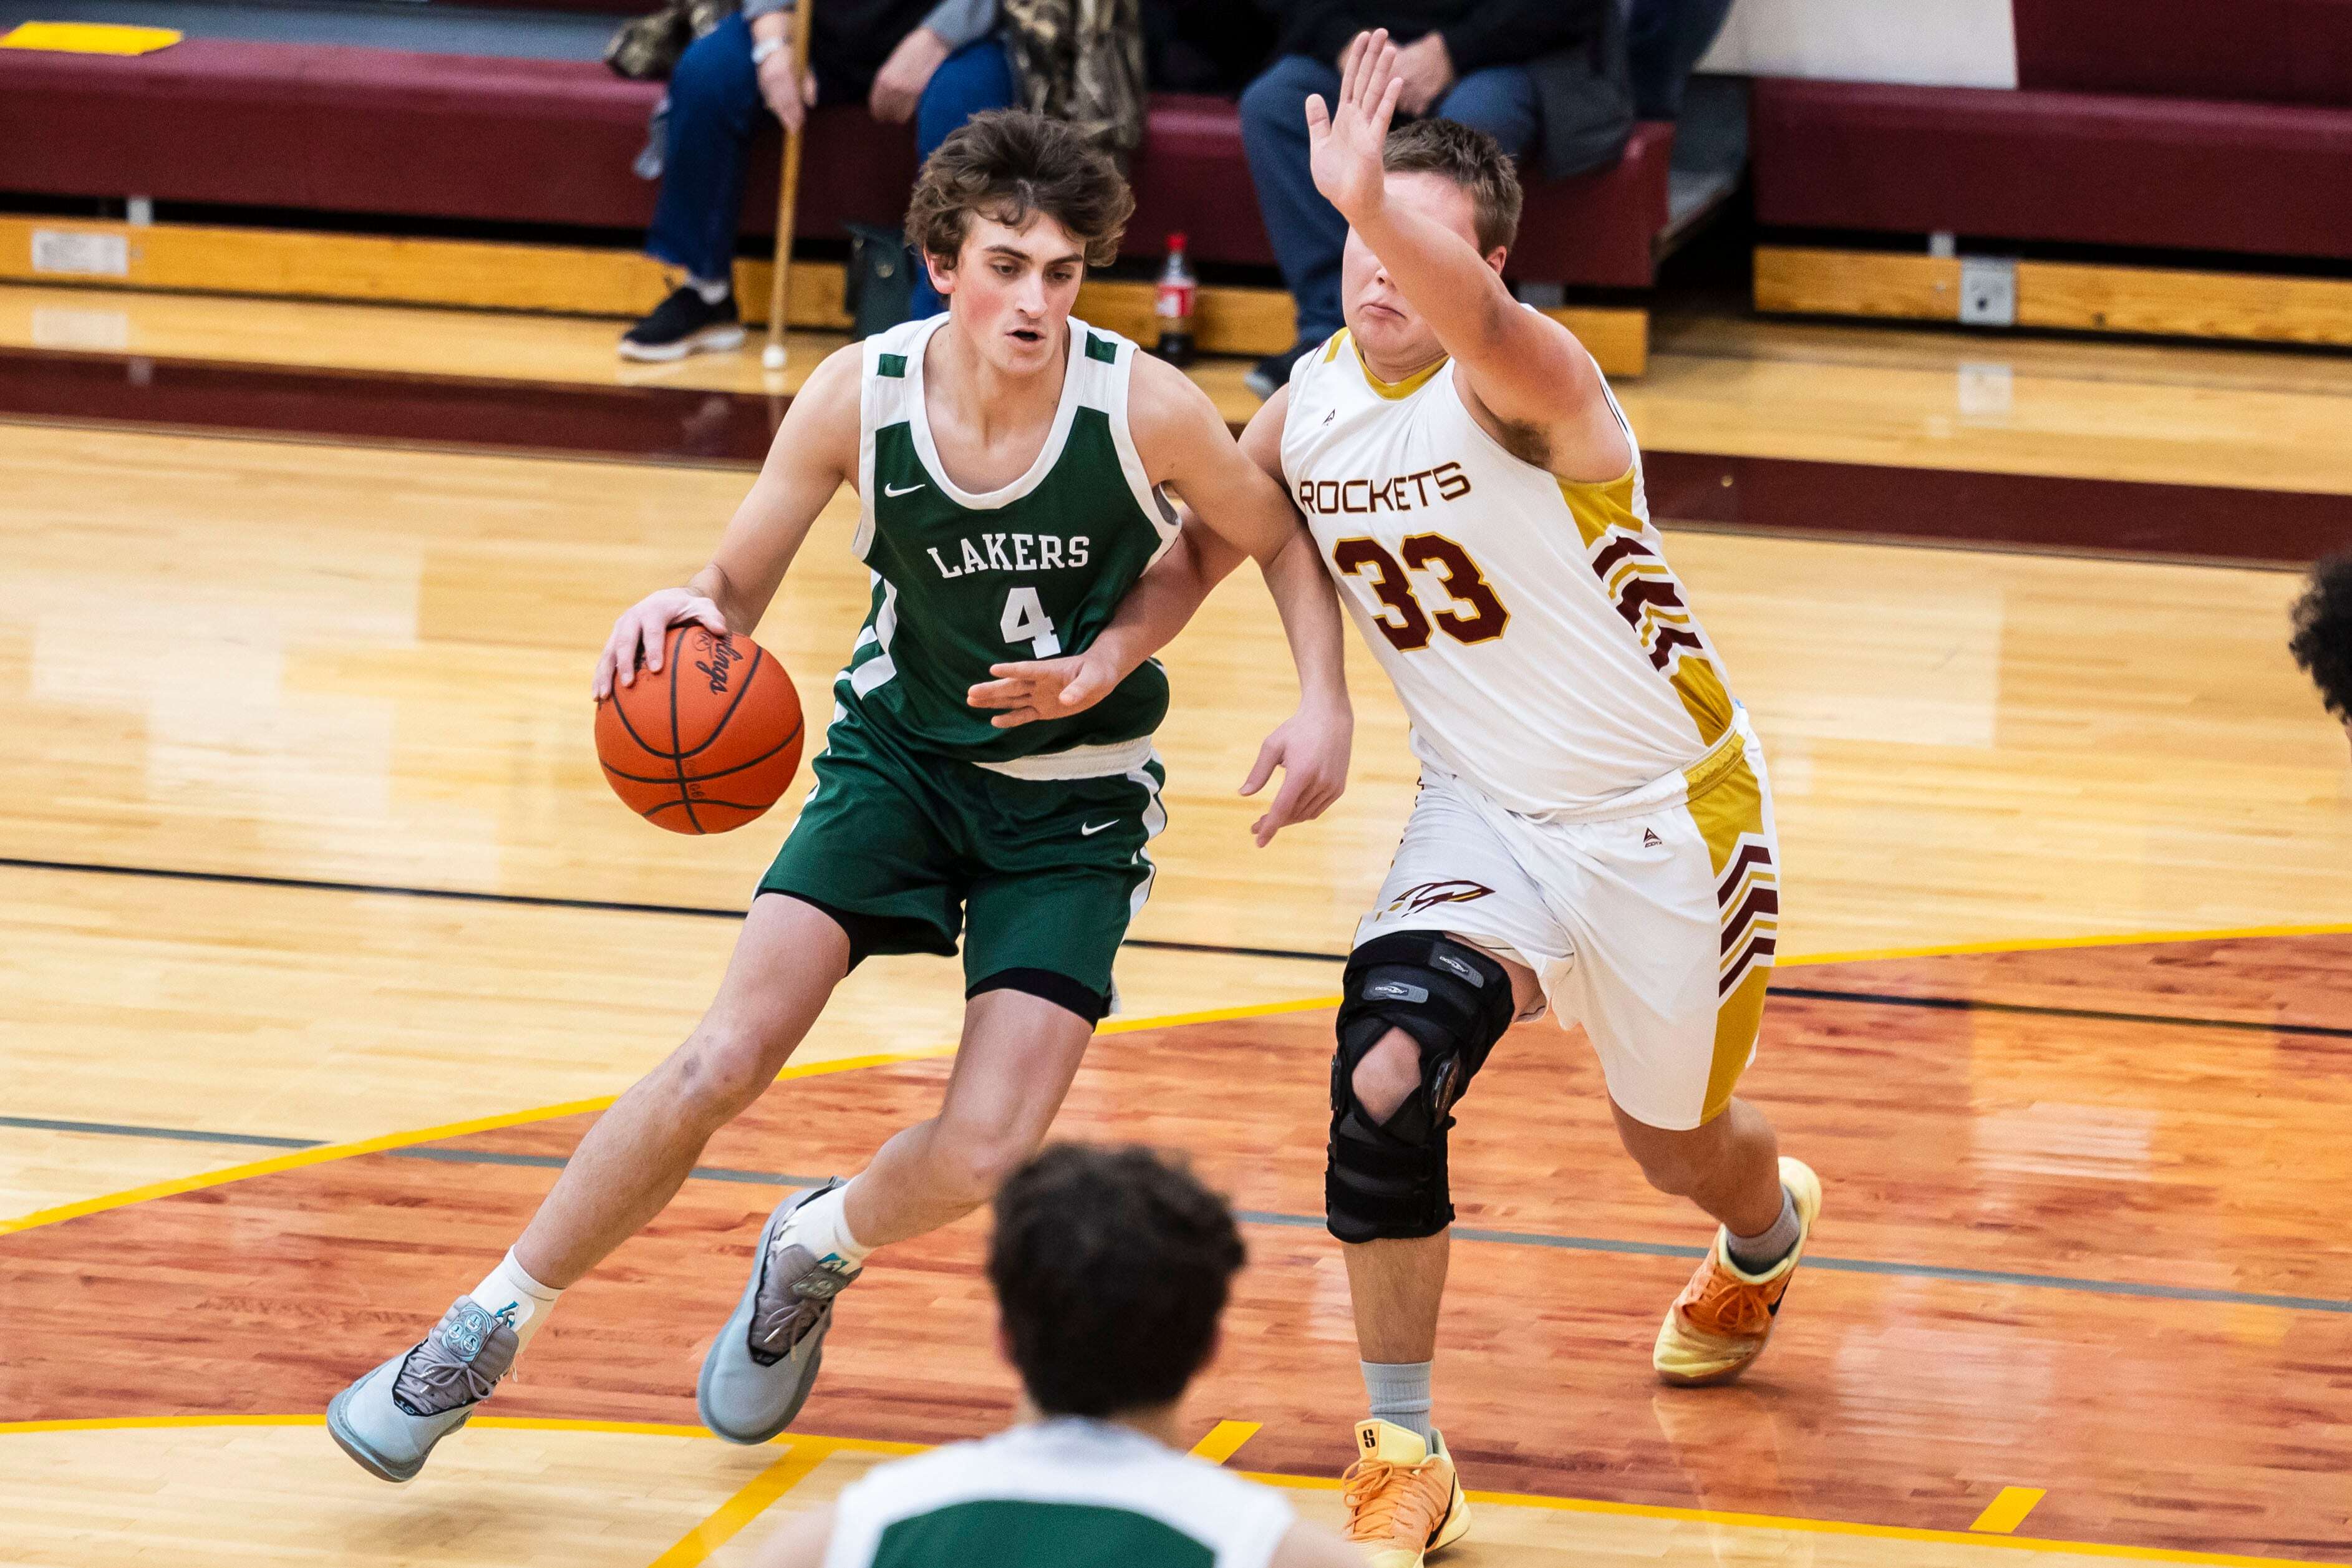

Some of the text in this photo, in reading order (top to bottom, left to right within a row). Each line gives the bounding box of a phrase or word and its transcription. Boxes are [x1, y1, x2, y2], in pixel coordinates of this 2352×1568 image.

[1299, 462, 1471, 514] ROCKETS
[927, 533, 1090, 578] LAKERS
[1000, 587, 1062, 659] 4
[1332, 531, 1511, 654] 33
